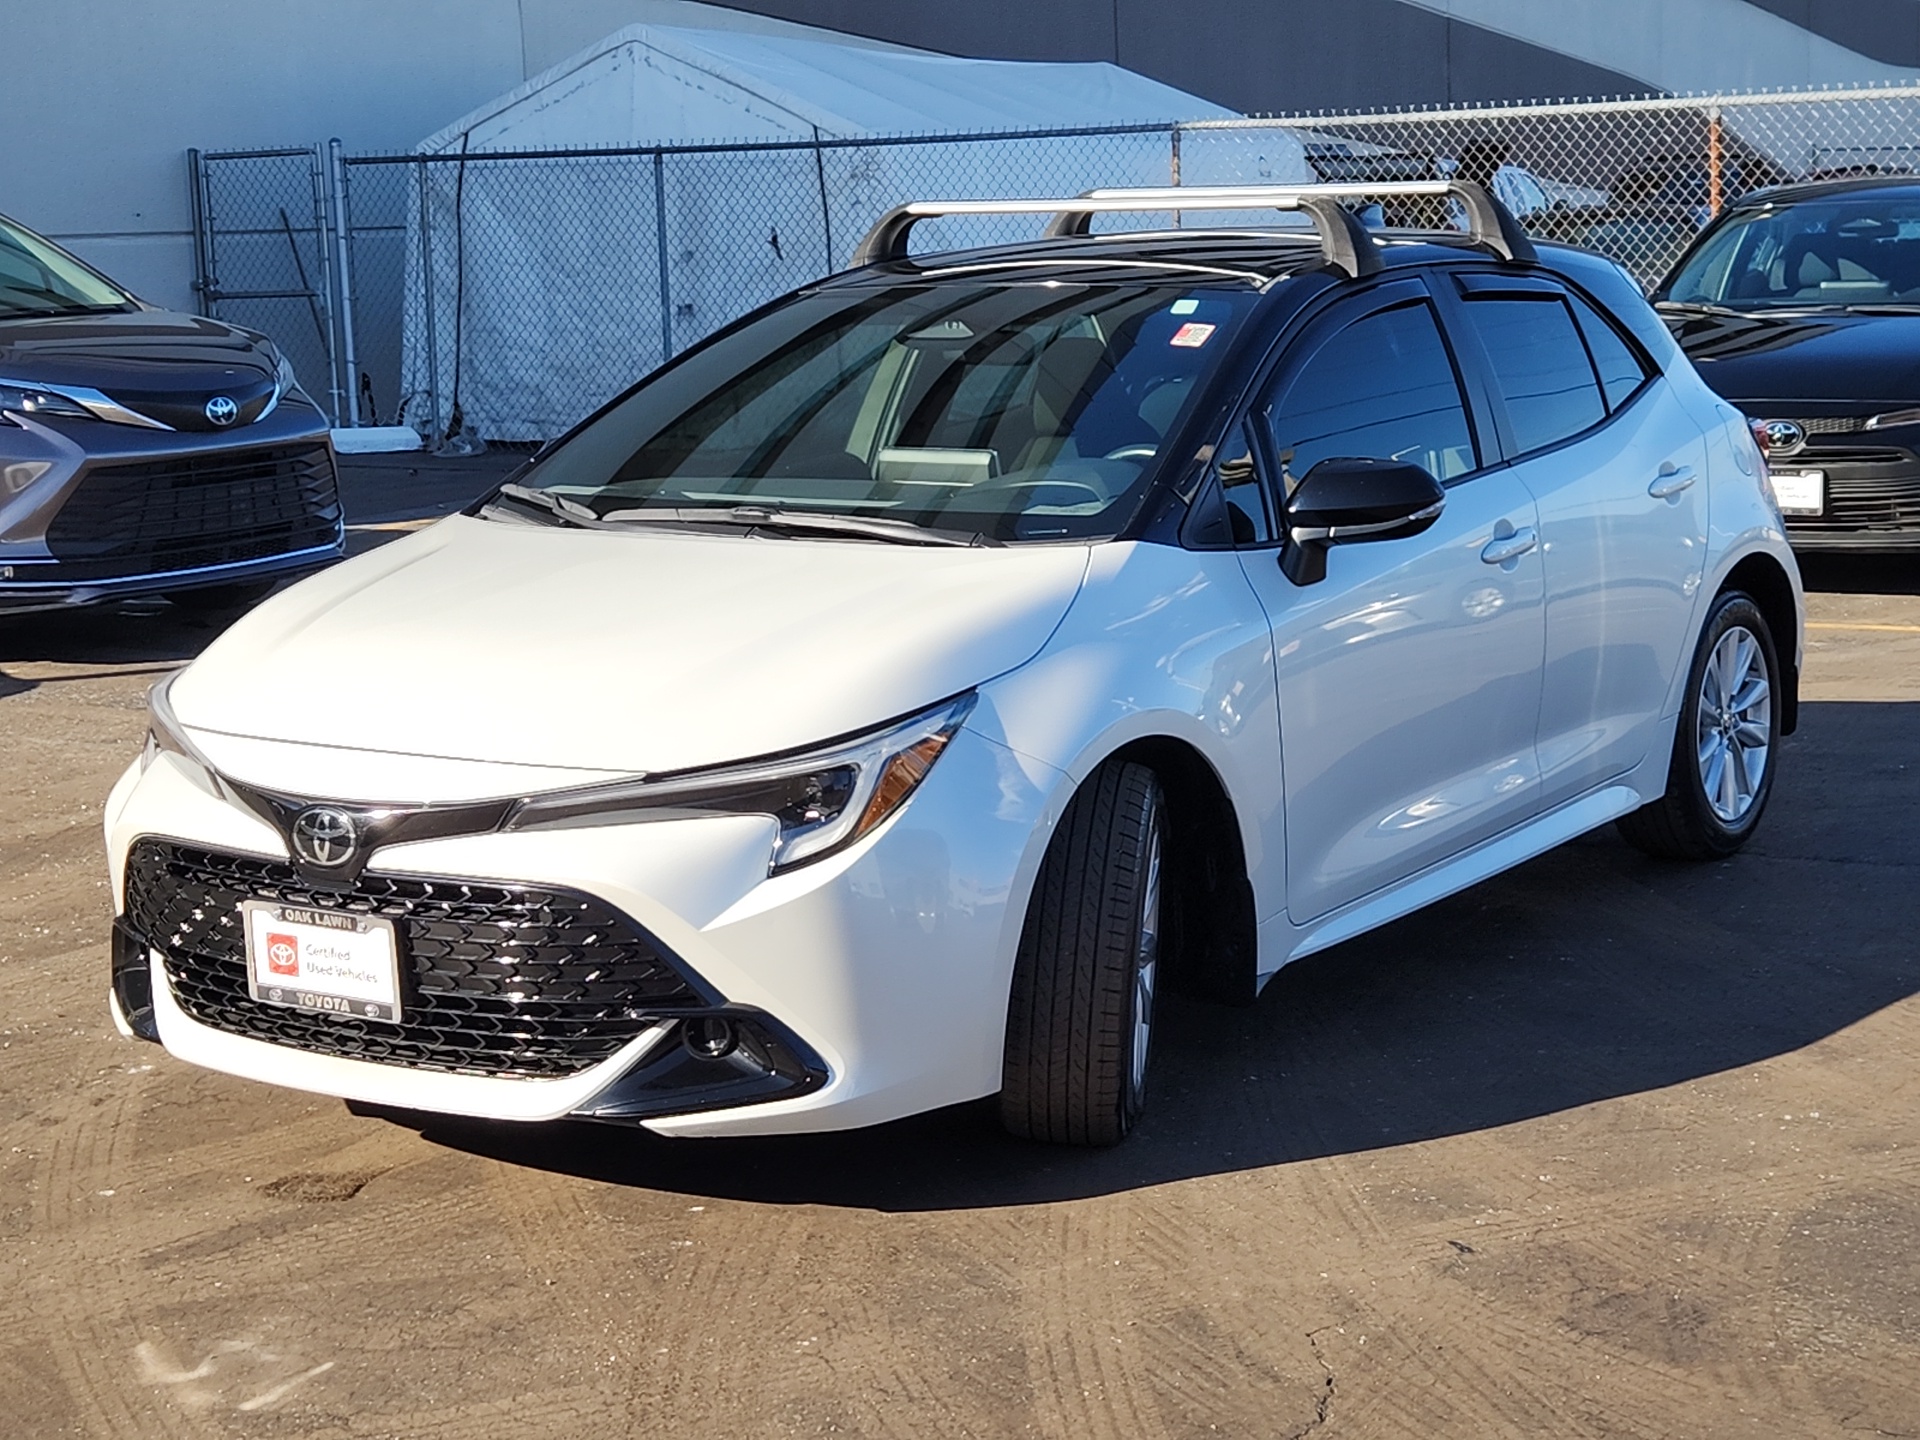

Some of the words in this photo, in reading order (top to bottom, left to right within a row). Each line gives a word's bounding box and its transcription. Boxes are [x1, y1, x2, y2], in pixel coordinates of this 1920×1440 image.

[285, 908, 312, 924] OAK
[314, 912, 352, 929] LAWN
[306, 962, 333, 975] Used
[296, 992, 351, 1012] TOYOTA
